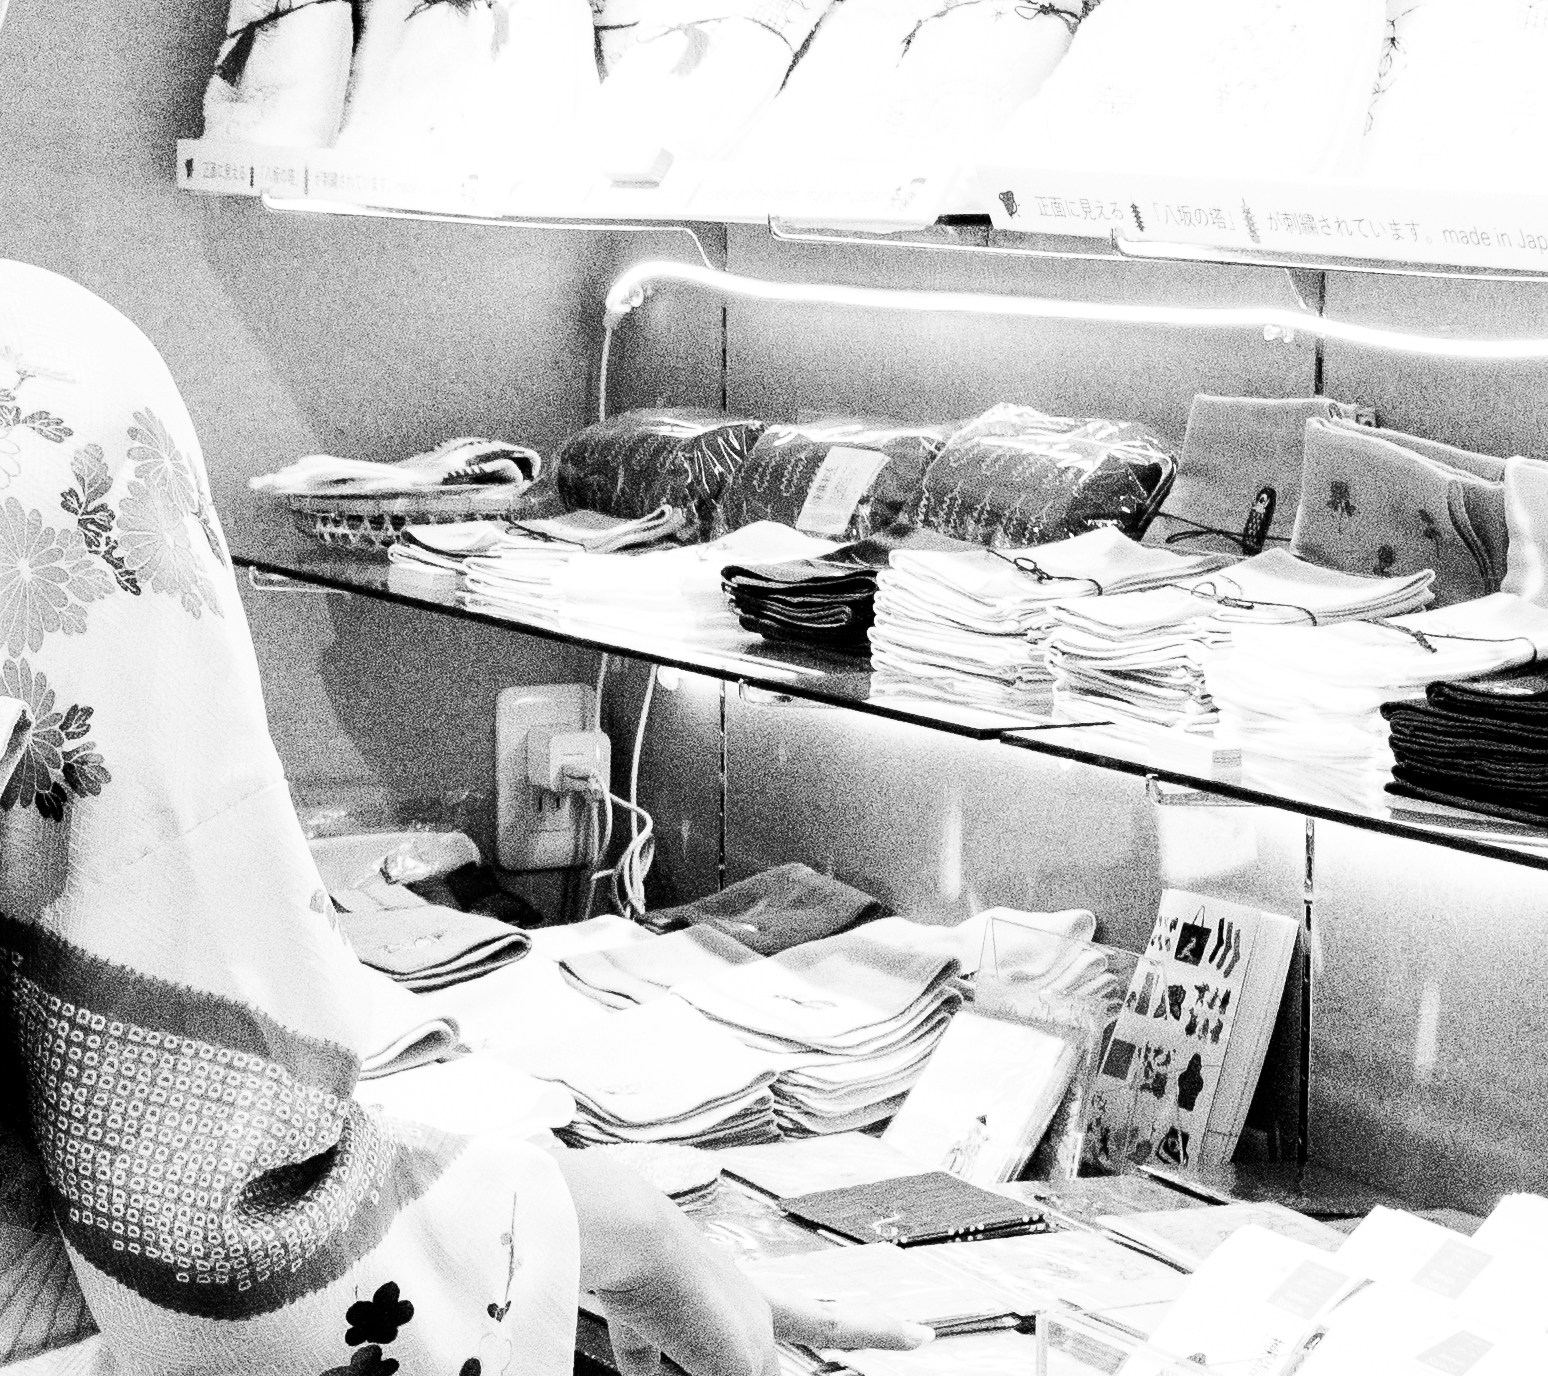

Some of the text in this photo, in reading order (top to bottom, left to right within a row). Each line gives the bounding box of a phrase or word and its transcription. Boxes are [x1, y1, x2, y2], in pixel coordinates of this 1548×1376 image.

[1035, 194, 1126, 223] 正面に見える
[1154, 199, 1237, 235] 「八坂の塔」
[1442, 224, 1492, 249] made
[1495, 227, 1512, 251] in
